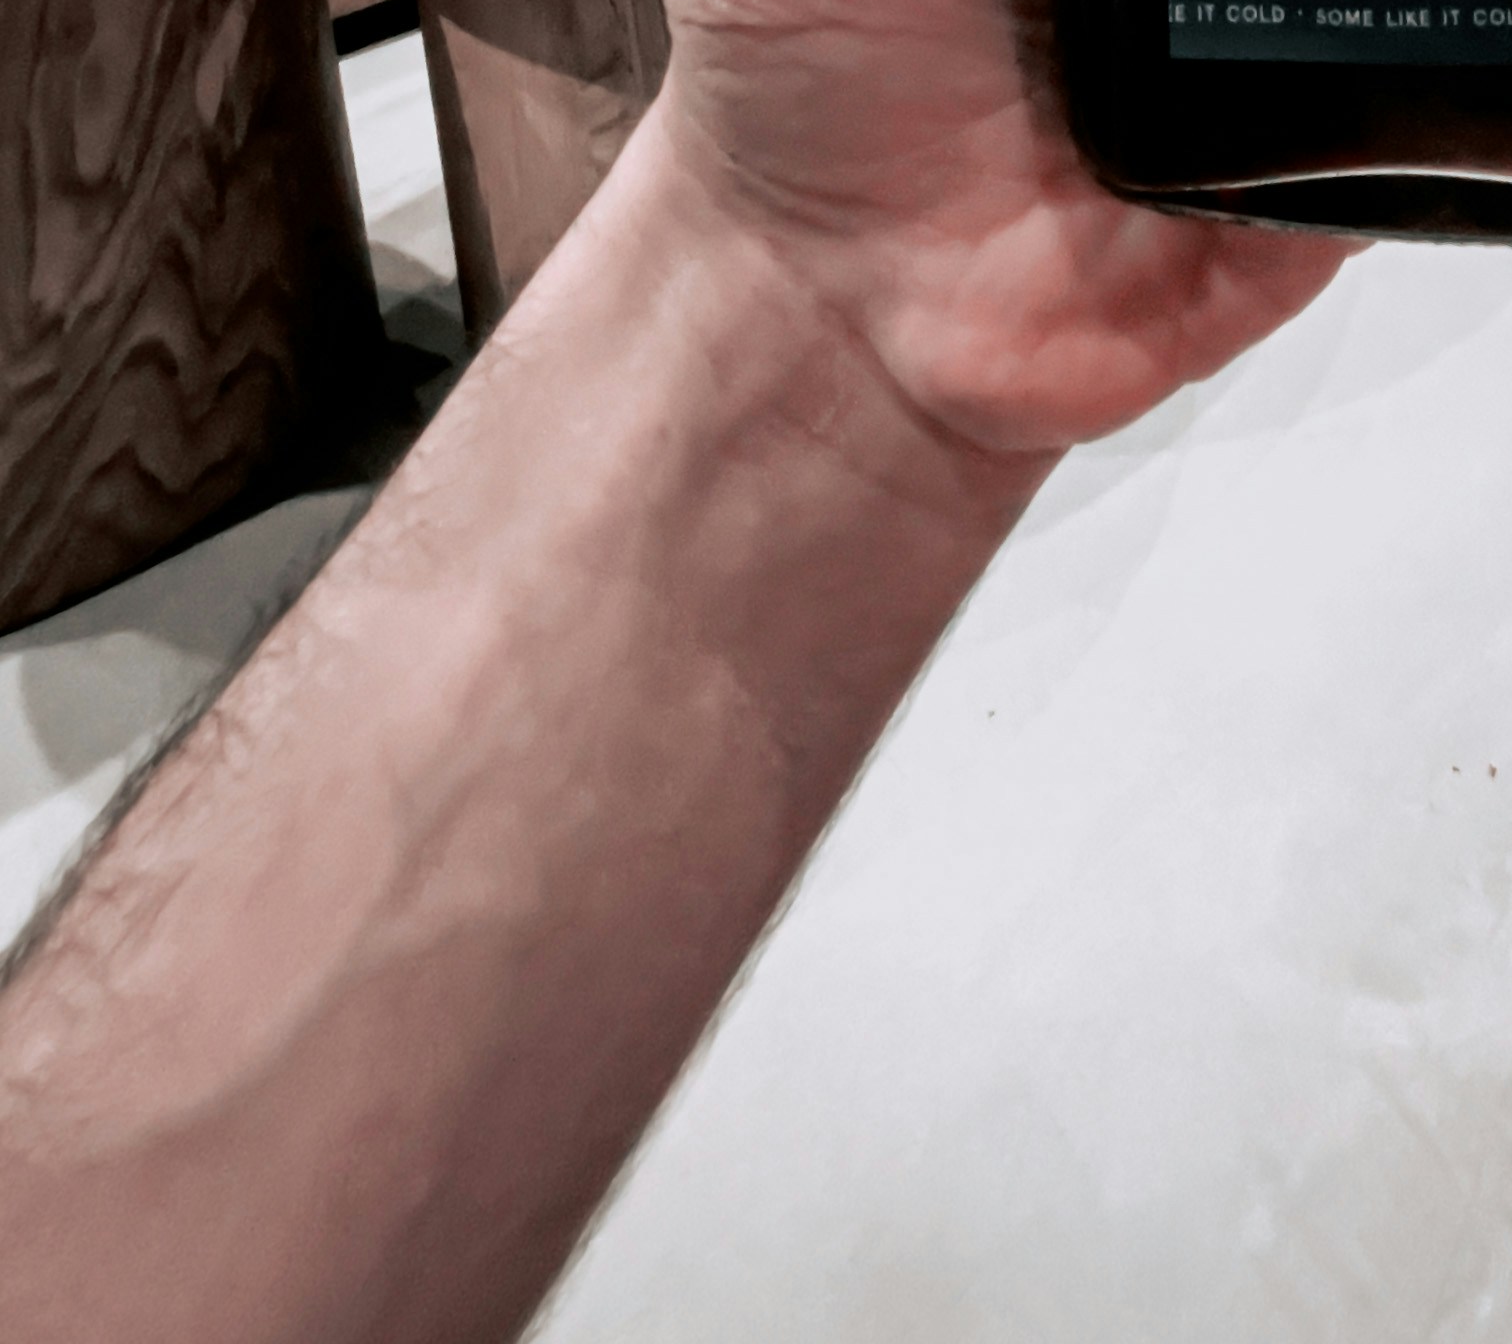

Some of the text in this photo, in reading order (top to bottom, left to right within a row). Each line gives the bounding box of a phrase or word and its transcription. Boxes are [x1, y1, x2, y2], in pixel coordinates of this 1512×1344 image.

[1197, 4, 1215, 22] IT
[1226, 5, 1286, 24] COLD
[1316, 8, 1373, 27] SOME
[1386, 9, 1429, 27] LIKE
[1443, 9, 1460, 26] IT
